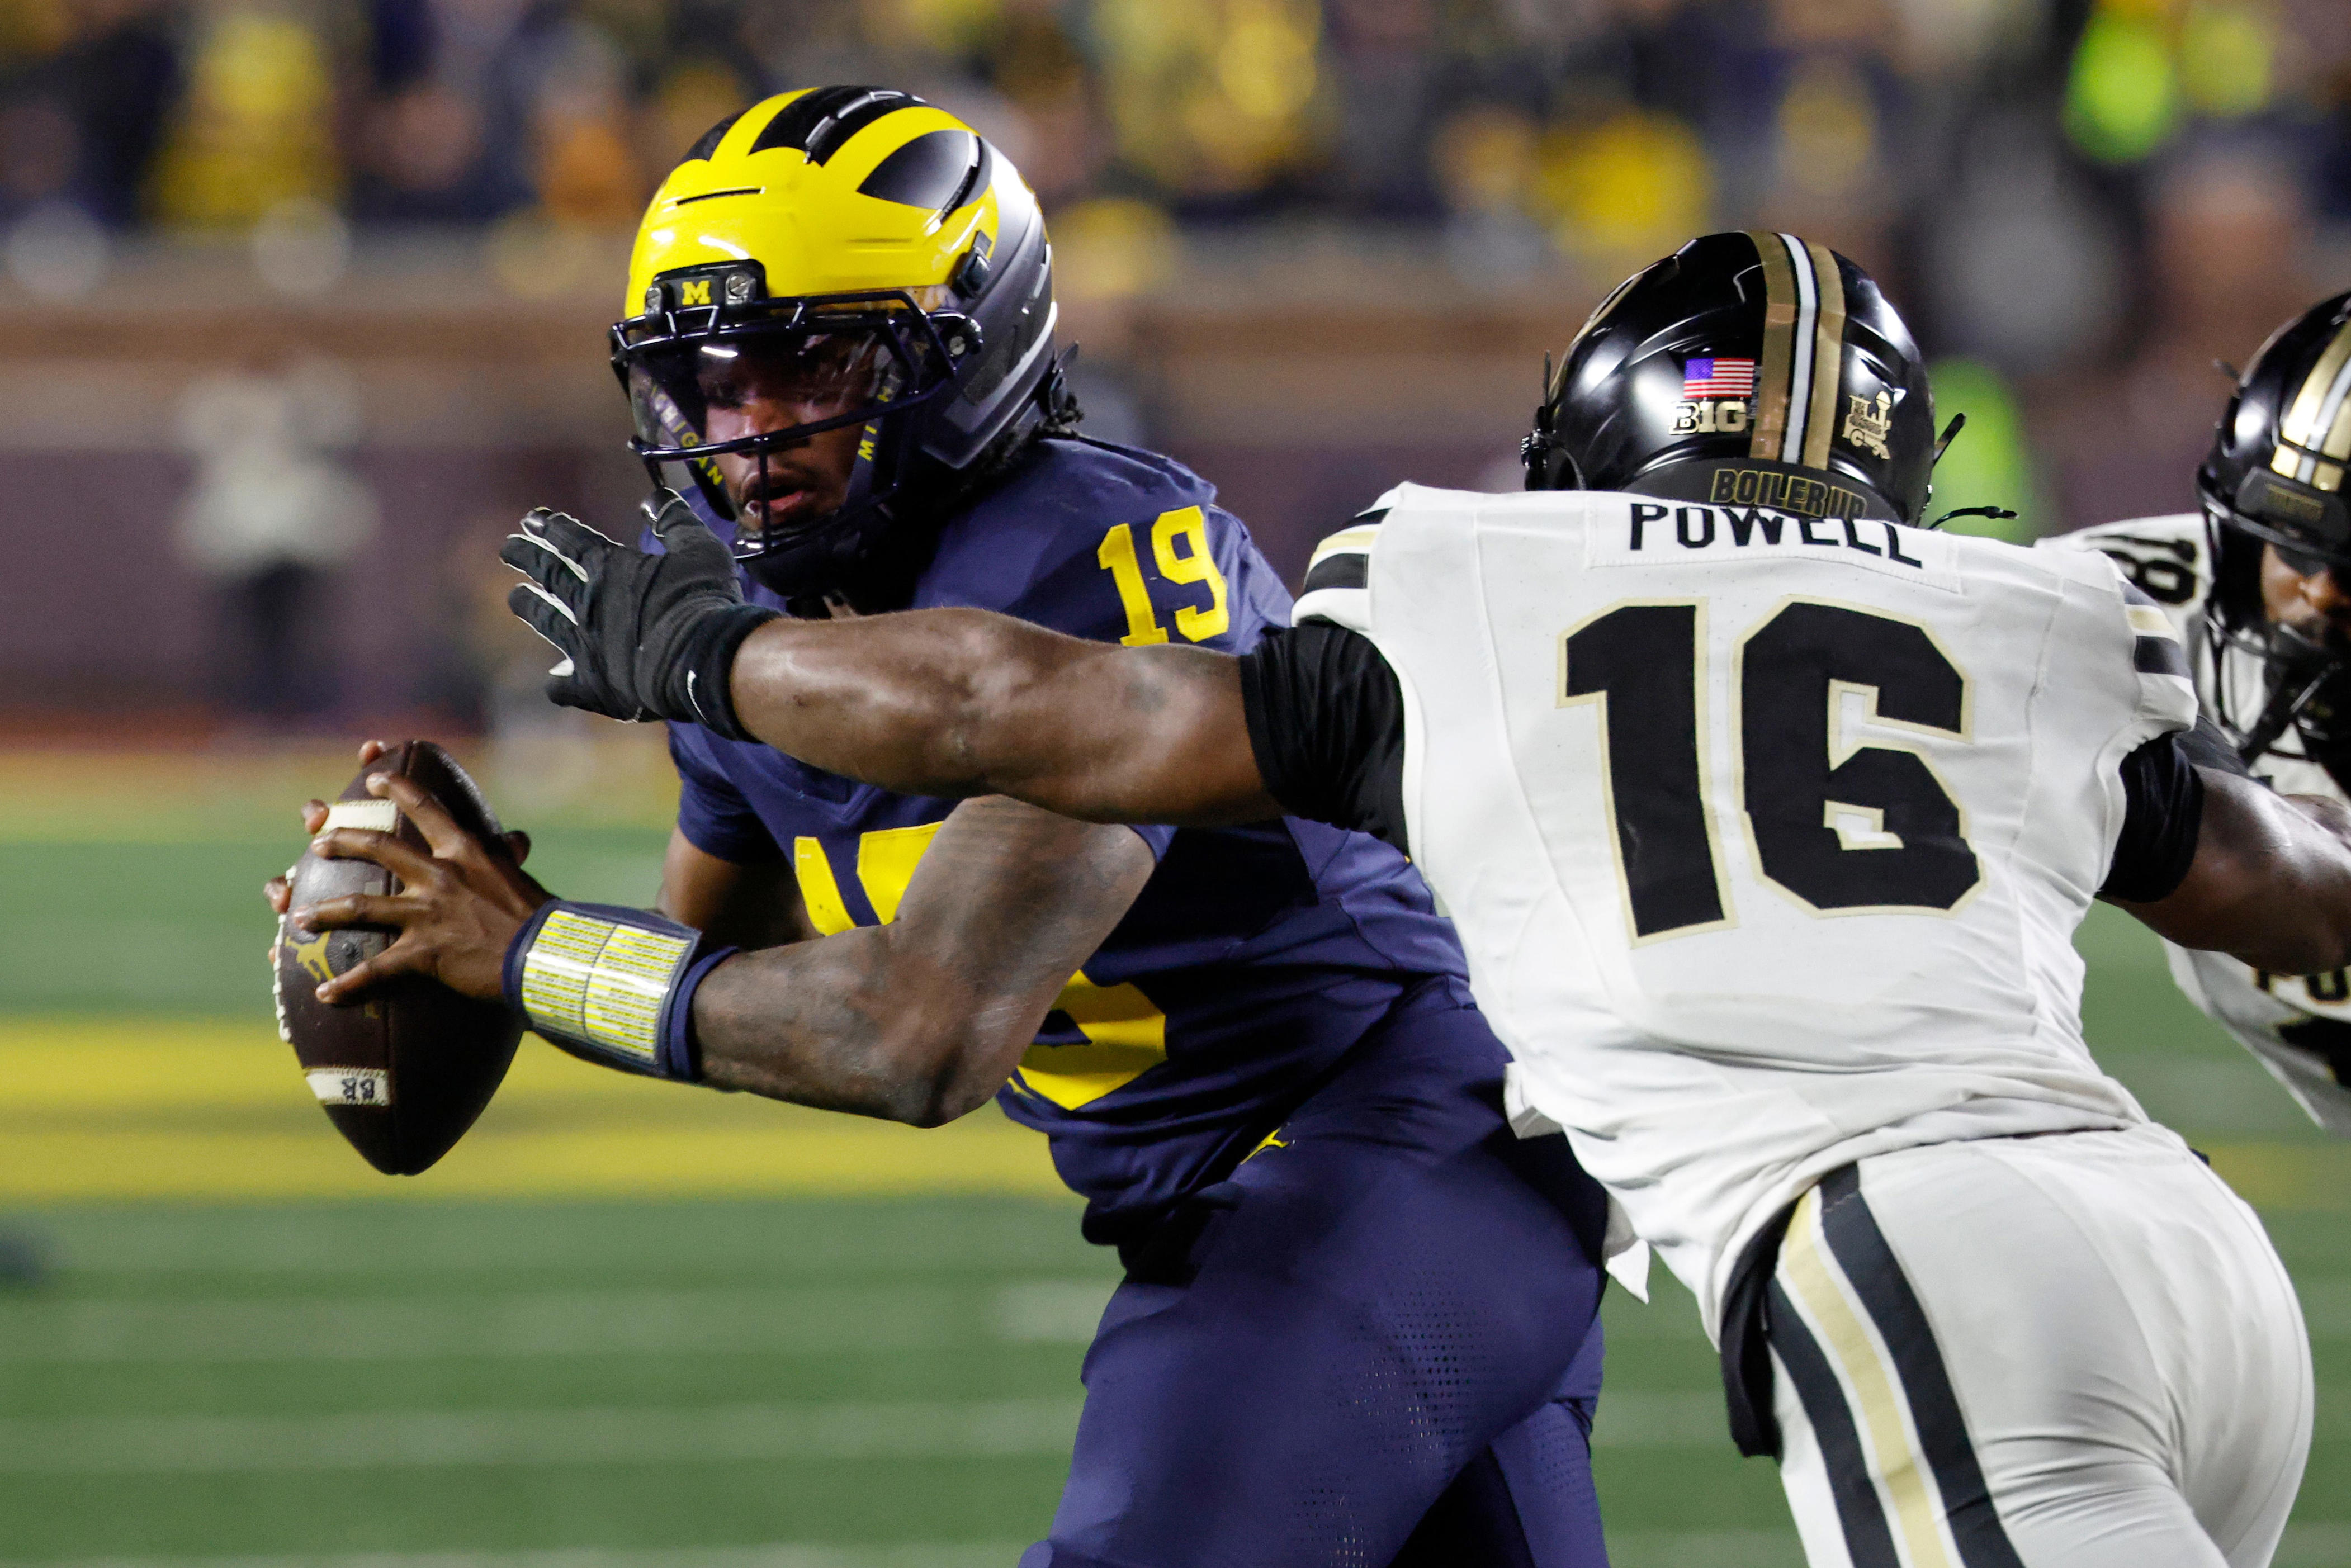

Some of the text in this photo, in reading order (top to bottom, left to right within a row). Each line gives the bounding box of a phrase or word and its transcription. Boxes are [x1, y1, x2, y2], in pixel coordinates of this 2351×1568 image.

[682, 280, 712, 305] M
[1710, 468, 1829, 518] BOILER
[1630, 503, 1922, 569] POWELL
[1096, 505, 1229, 647] 19
[1555, 594, 1988, 950] 16
